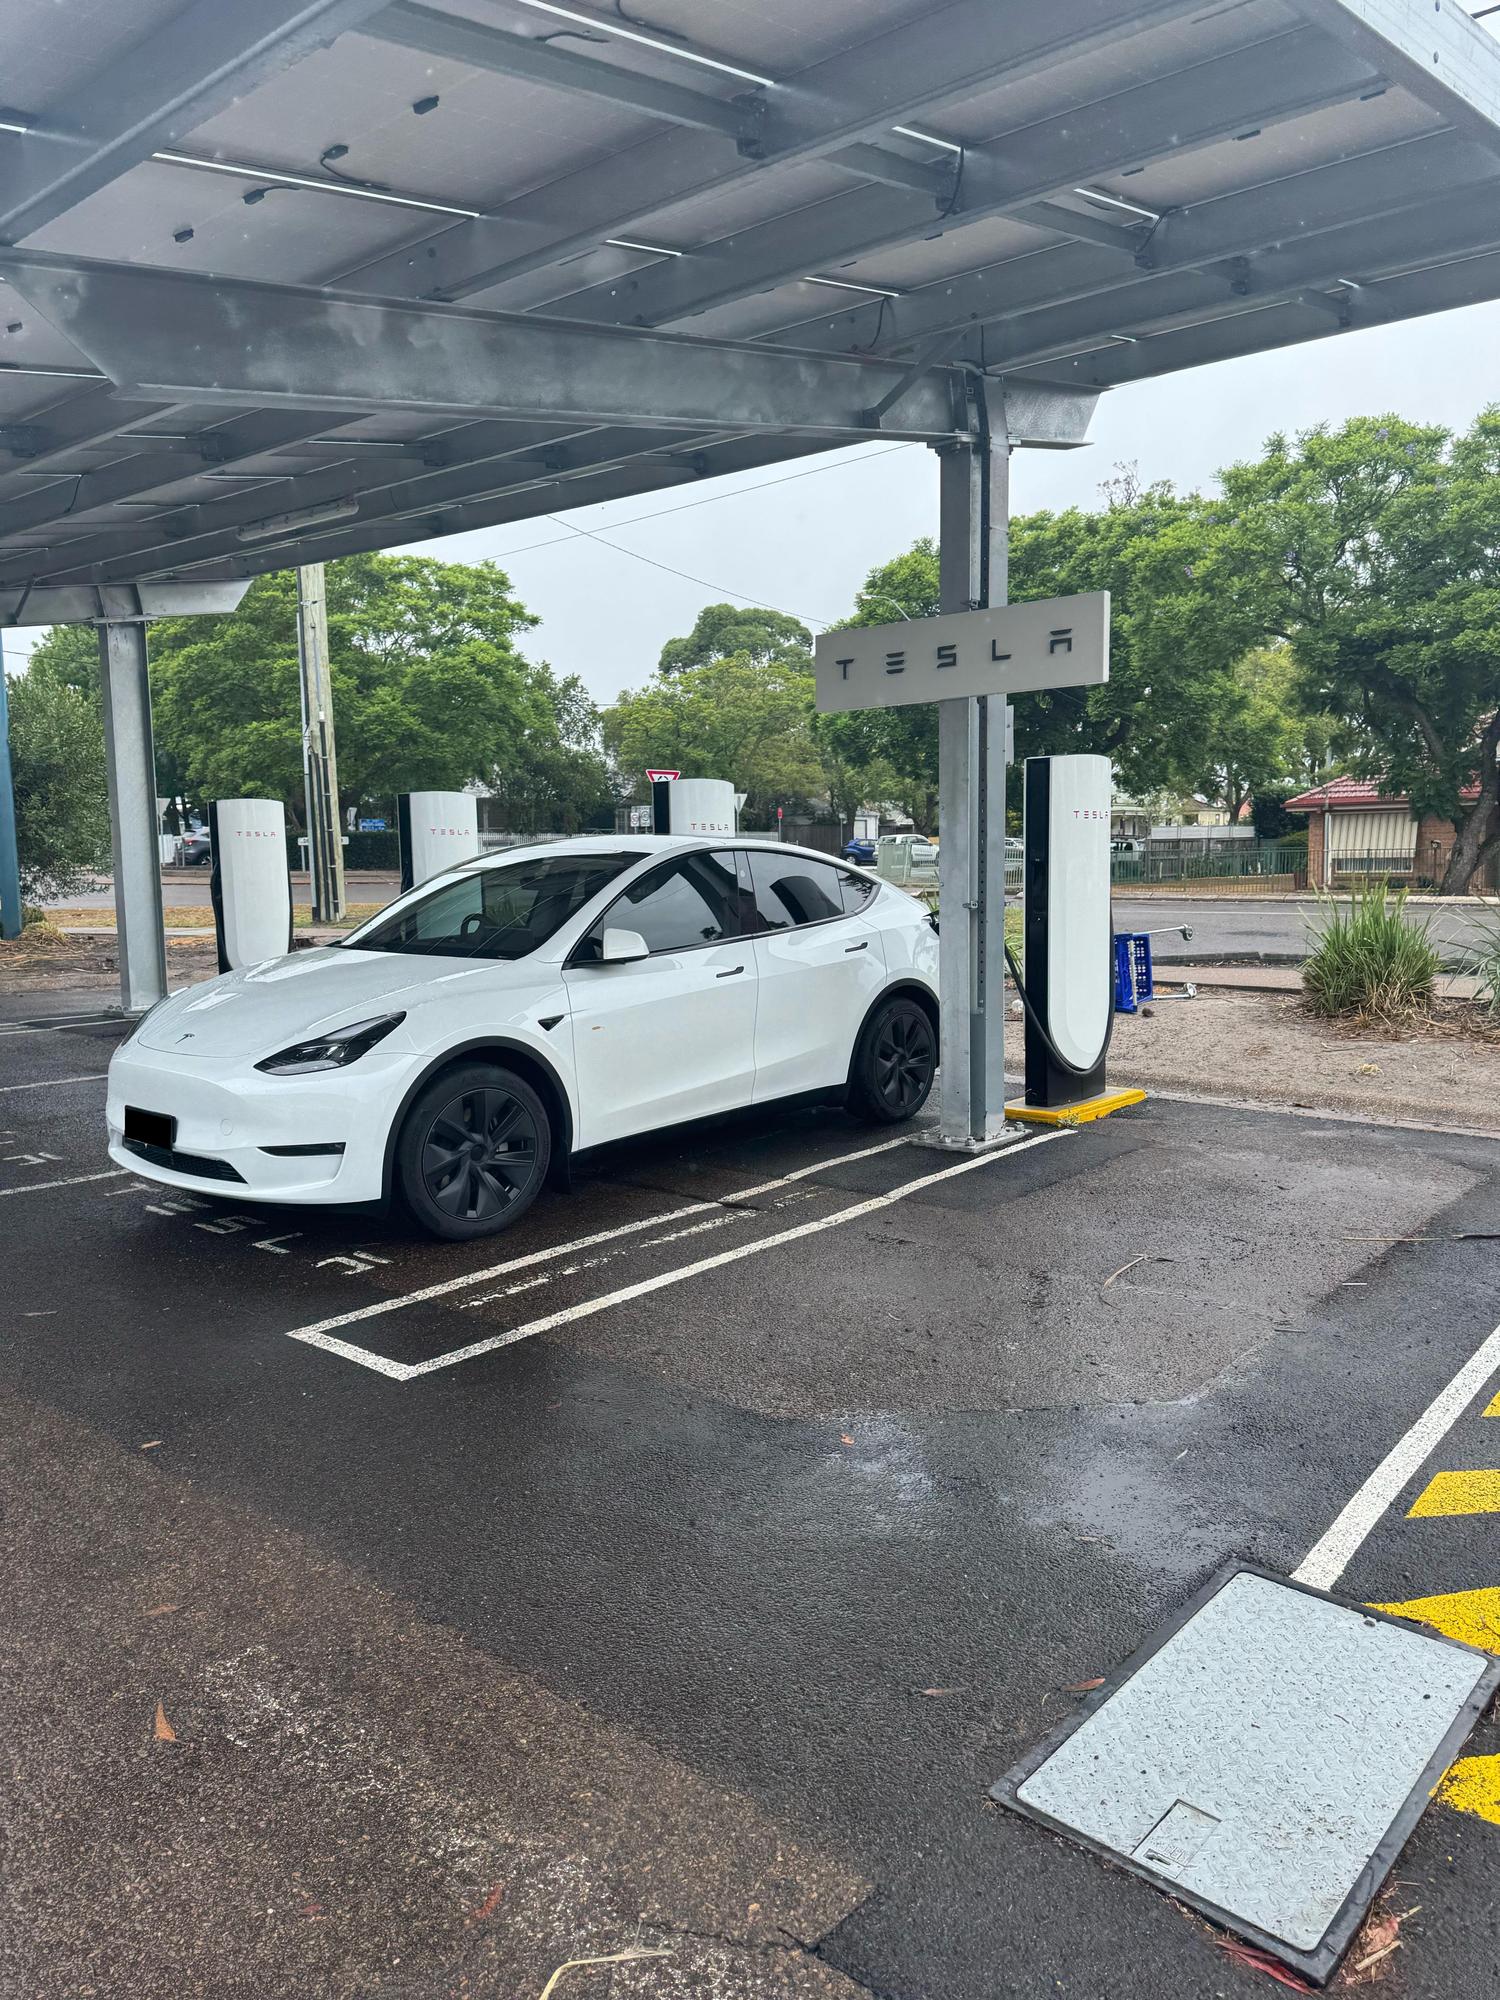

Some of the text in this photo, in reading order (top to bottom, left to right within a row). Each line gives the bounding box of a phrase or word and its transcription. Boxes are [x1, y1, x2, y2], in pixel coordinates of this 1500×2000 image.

[835, 628, 1073, 681] TESLA
[1072, 810, 1109, 819] TESLA
[690, 823, 729, 831] TESLA
[236, 830, 277, 838] TESLA
[430, 828, 470, 836] TESLA
[104, 1182, 394, 1276] TESLA
